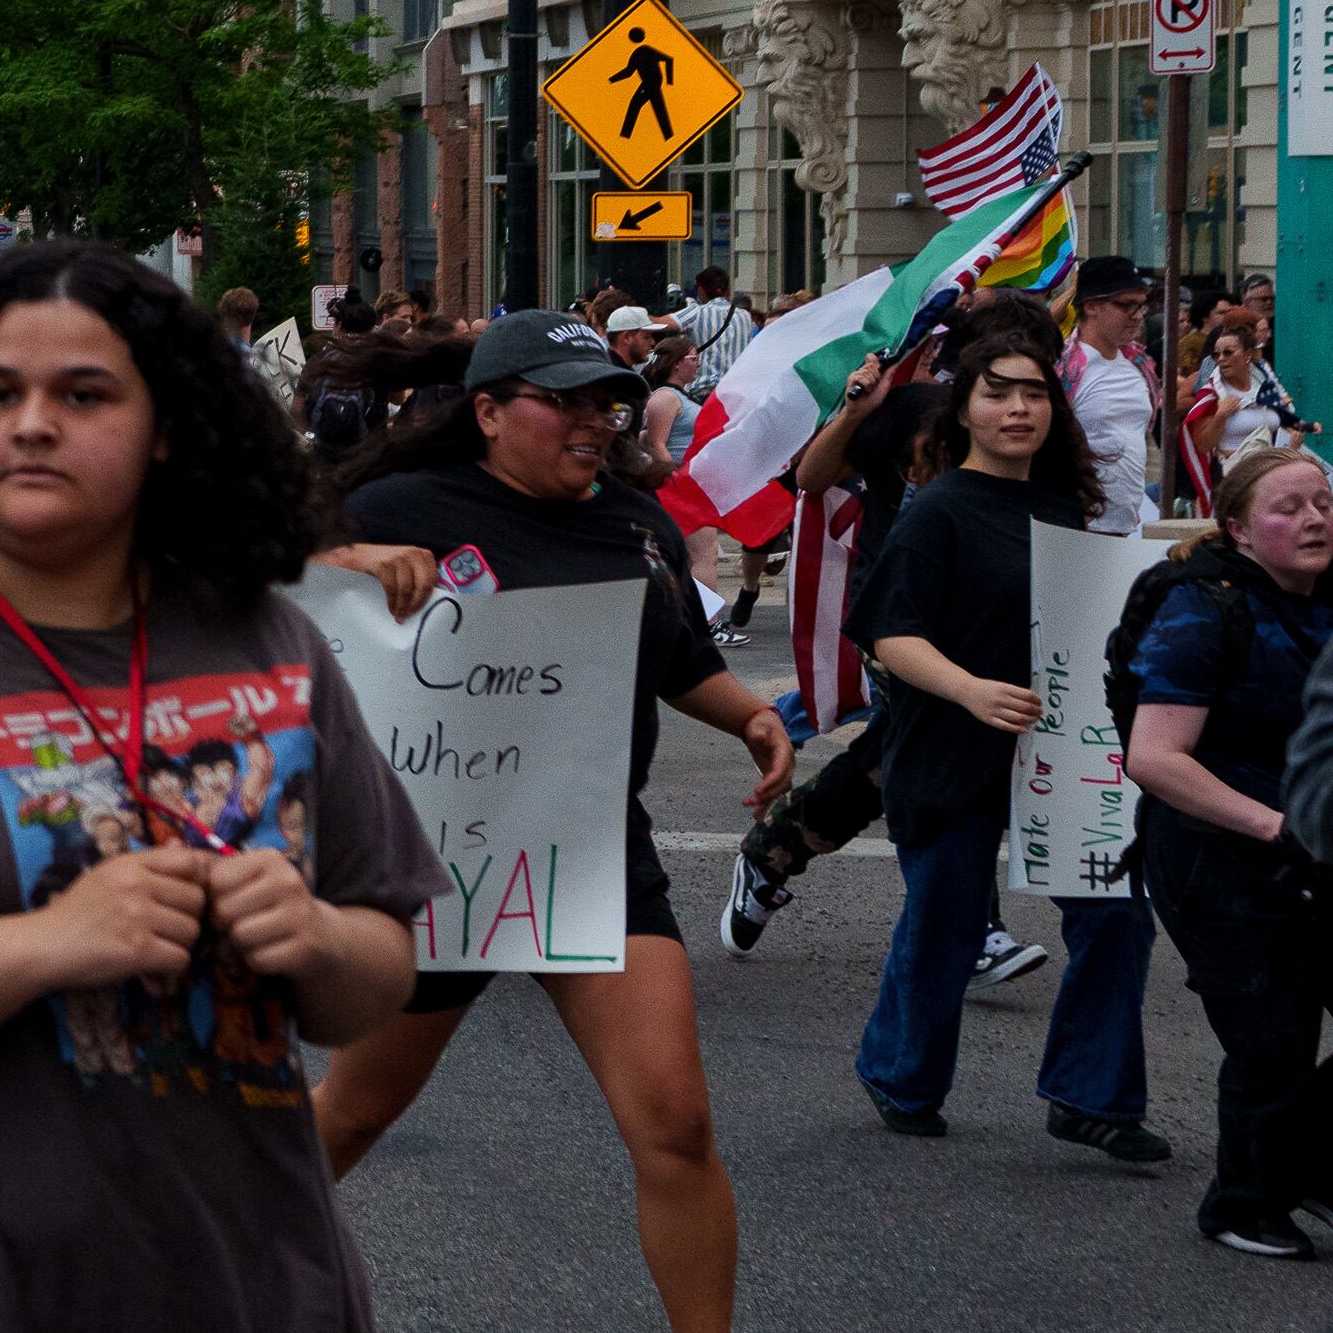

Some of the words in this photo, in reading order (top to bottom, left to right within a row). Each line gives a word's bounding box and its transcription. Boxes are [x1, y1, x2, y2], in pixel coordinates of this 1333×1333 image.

[412, 596, 564, 696] Comes
[1033, 648, 1070, 737] People
[1028, 753, 1054, 795] Our
